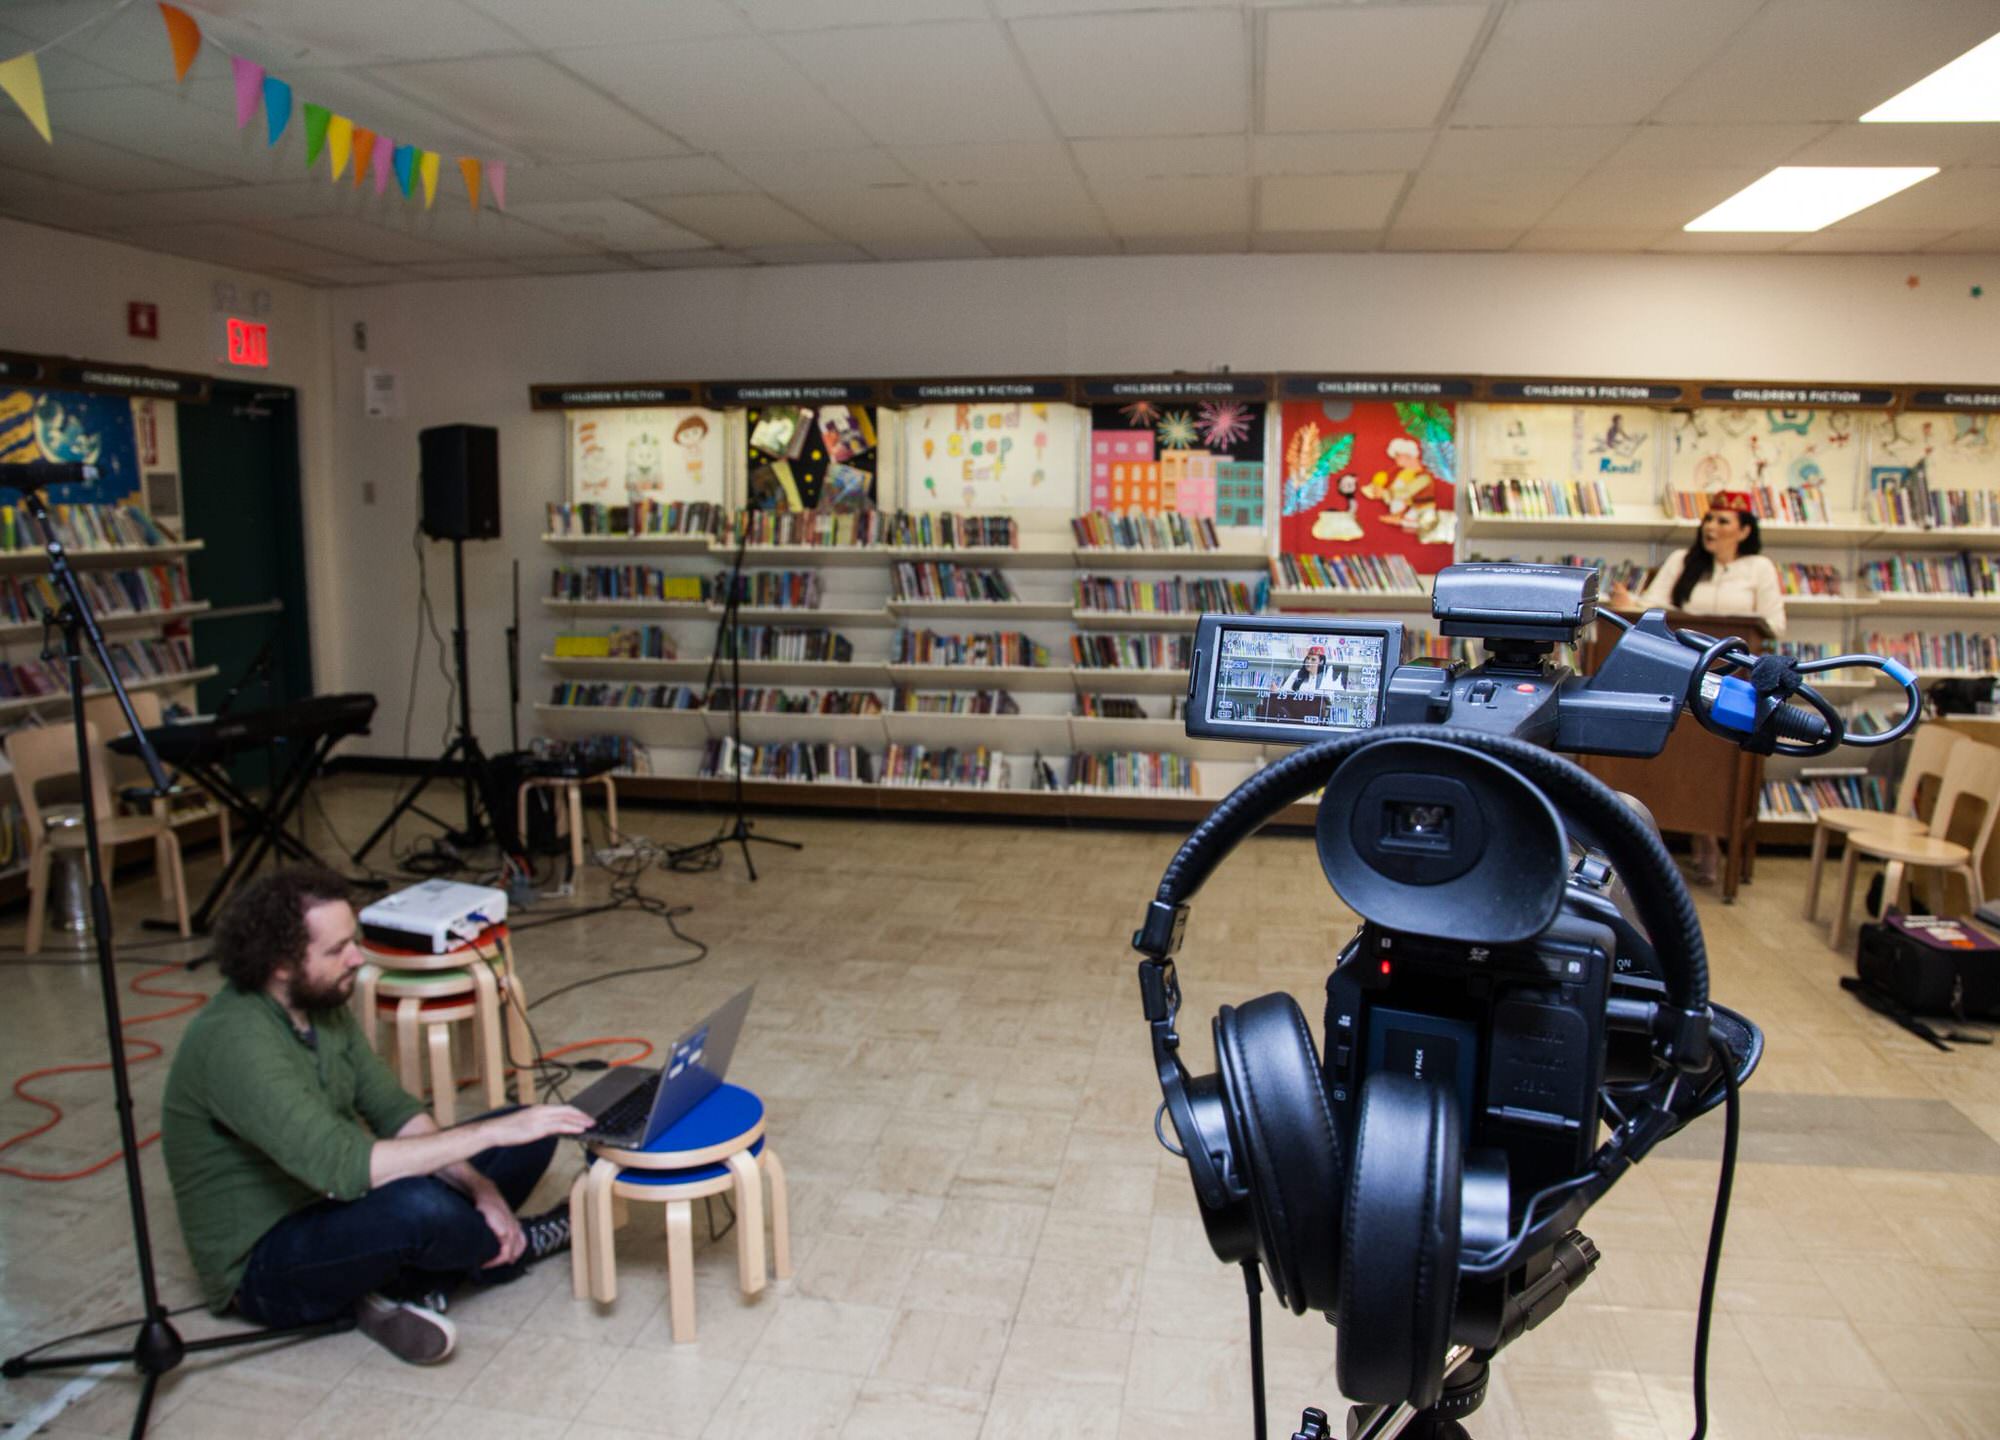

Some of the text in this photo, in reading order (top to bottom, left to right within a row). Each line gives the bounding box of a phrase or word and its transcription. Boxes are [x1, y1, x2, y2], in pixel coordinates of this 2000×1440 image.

[227, 318, 268, 367] EXIT
[737, 386, 848, 399] CHILDREN'S FICTION
[918, 384, 1034, 397] CHILDREN'S FICTION
[1112, 382, 1234, 395] CHILDREN'S FICTION
[1317, 381, 1441, 393] CHILDREN'S FICTION
[1523, 384, 1650, 398] CHILDREN'S FICTION
[561, 389, 665, 402] CHILDREN'S FICTION
[1732, 388, 1861, 403] CHILDREN'S FICTION
[947, 432, 1013, 465] Seep
[1257, 690, 1271, 698] JUN
[1277, 691, 1288, 700] 29
[1293, 693, 1315, 701] 2019
[1617, 958, 1631, 968] ON
[1415, 1049, 1424, 1069] PACK
